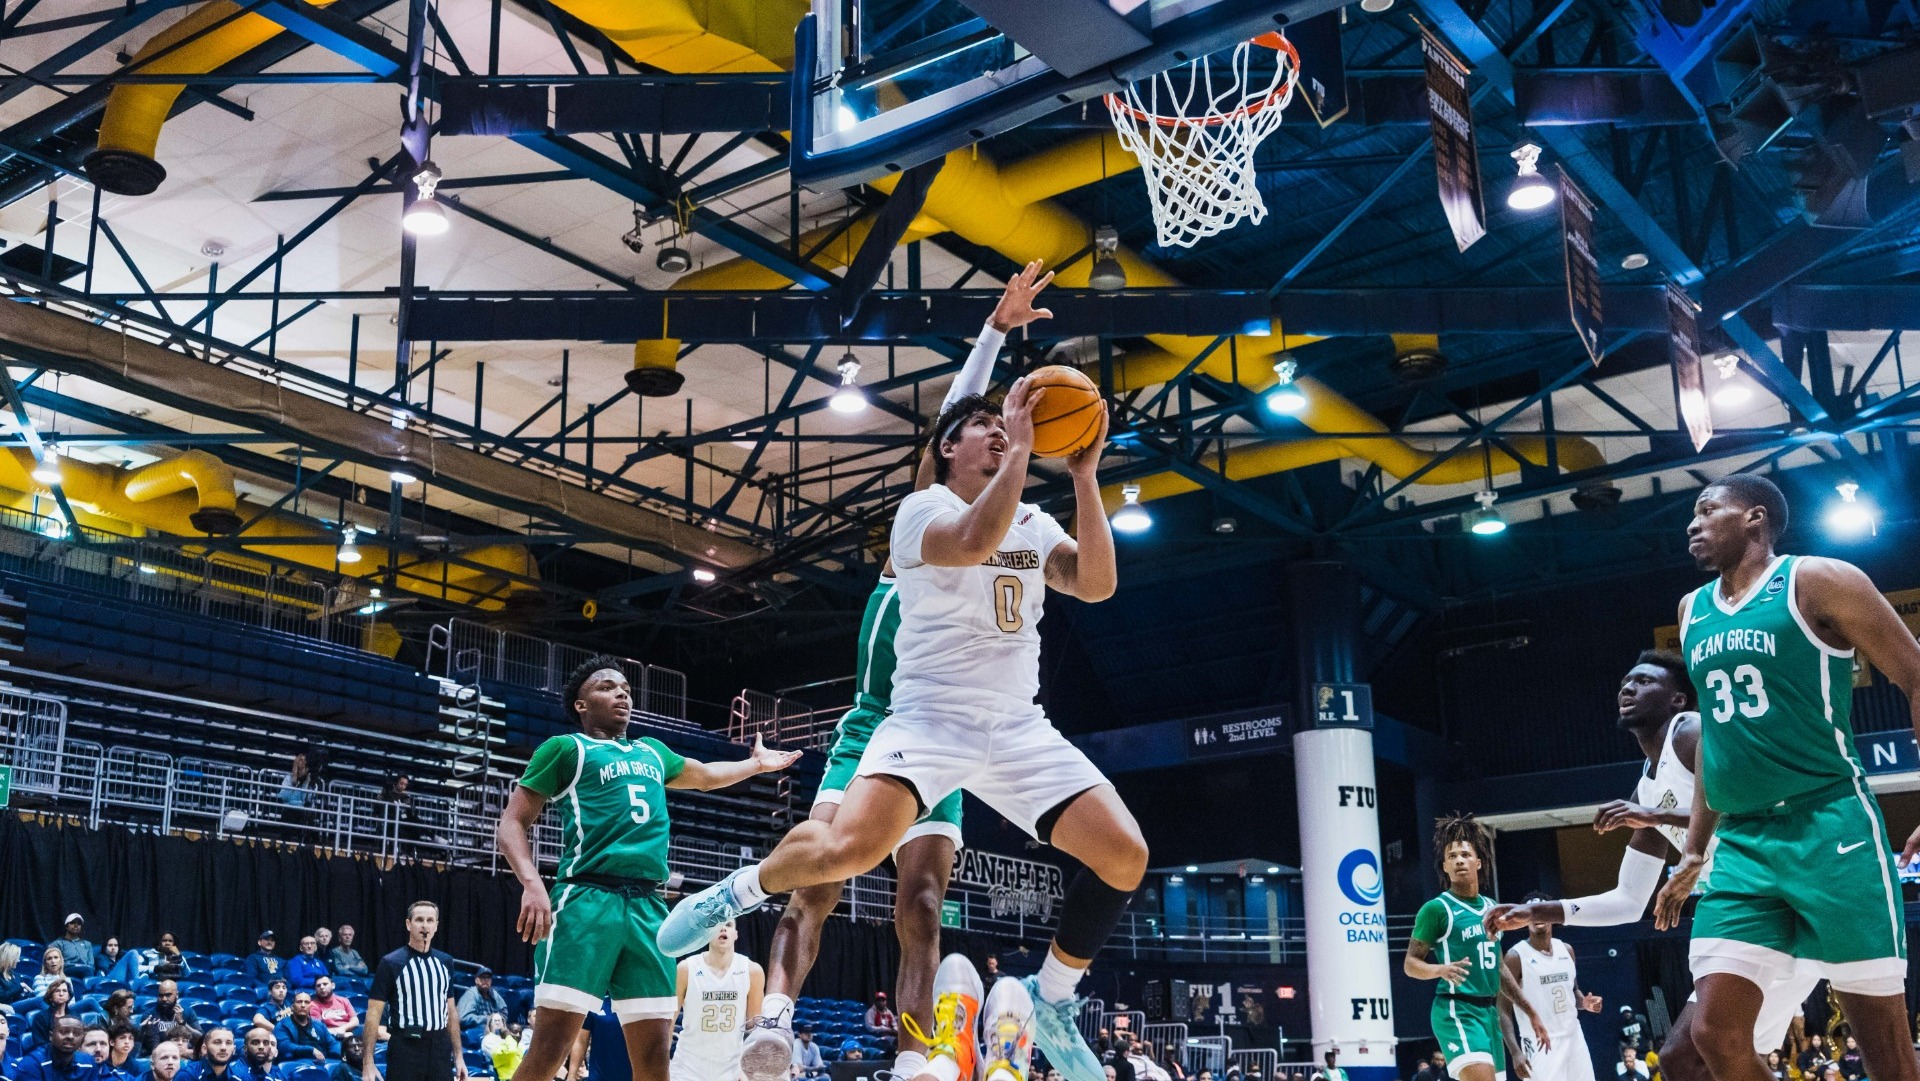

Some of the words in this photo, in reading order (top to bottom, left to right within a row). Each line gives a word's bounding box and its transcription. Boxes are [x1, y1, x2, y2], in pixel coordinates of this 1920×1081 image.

[993, 575, 1024, 633] 0
[1691, 631, 1725, 671] MEAN
[1726, 628, 1776, 658] GREEN
[1340, 690, 1359, 721] 1
[1705, 663, 1770, 724] 33
[1222, 716, 1282, 734] RESTROOMS
[1228, 733, 1245, 742] 2nd
[1247, 727, 1276, 739] LEVEL
[599, 760, 631, 786] MEAN
[629, 760, 662, 787] GREEN
[627, 783, 650, 824] 5
[1338, 785, 1375, 809] FIU
[949, 848, 1064, 900] PANTHER
[1339, 912, 1386, 926] OCEAN
[1461, 923, 1483, 942] MEAN
[1347, 929, 1385, 943] BANK
[1476, 941, 1496, 970] 15
[1189, 984, 1213, 998] FIU
[1217, 982, 1236, 1015] 1
[1551, 985, 1567, 1015] 2
[701, 1004, 736, 1032] 23
[1351, 998, 1390, 1020] FIU
